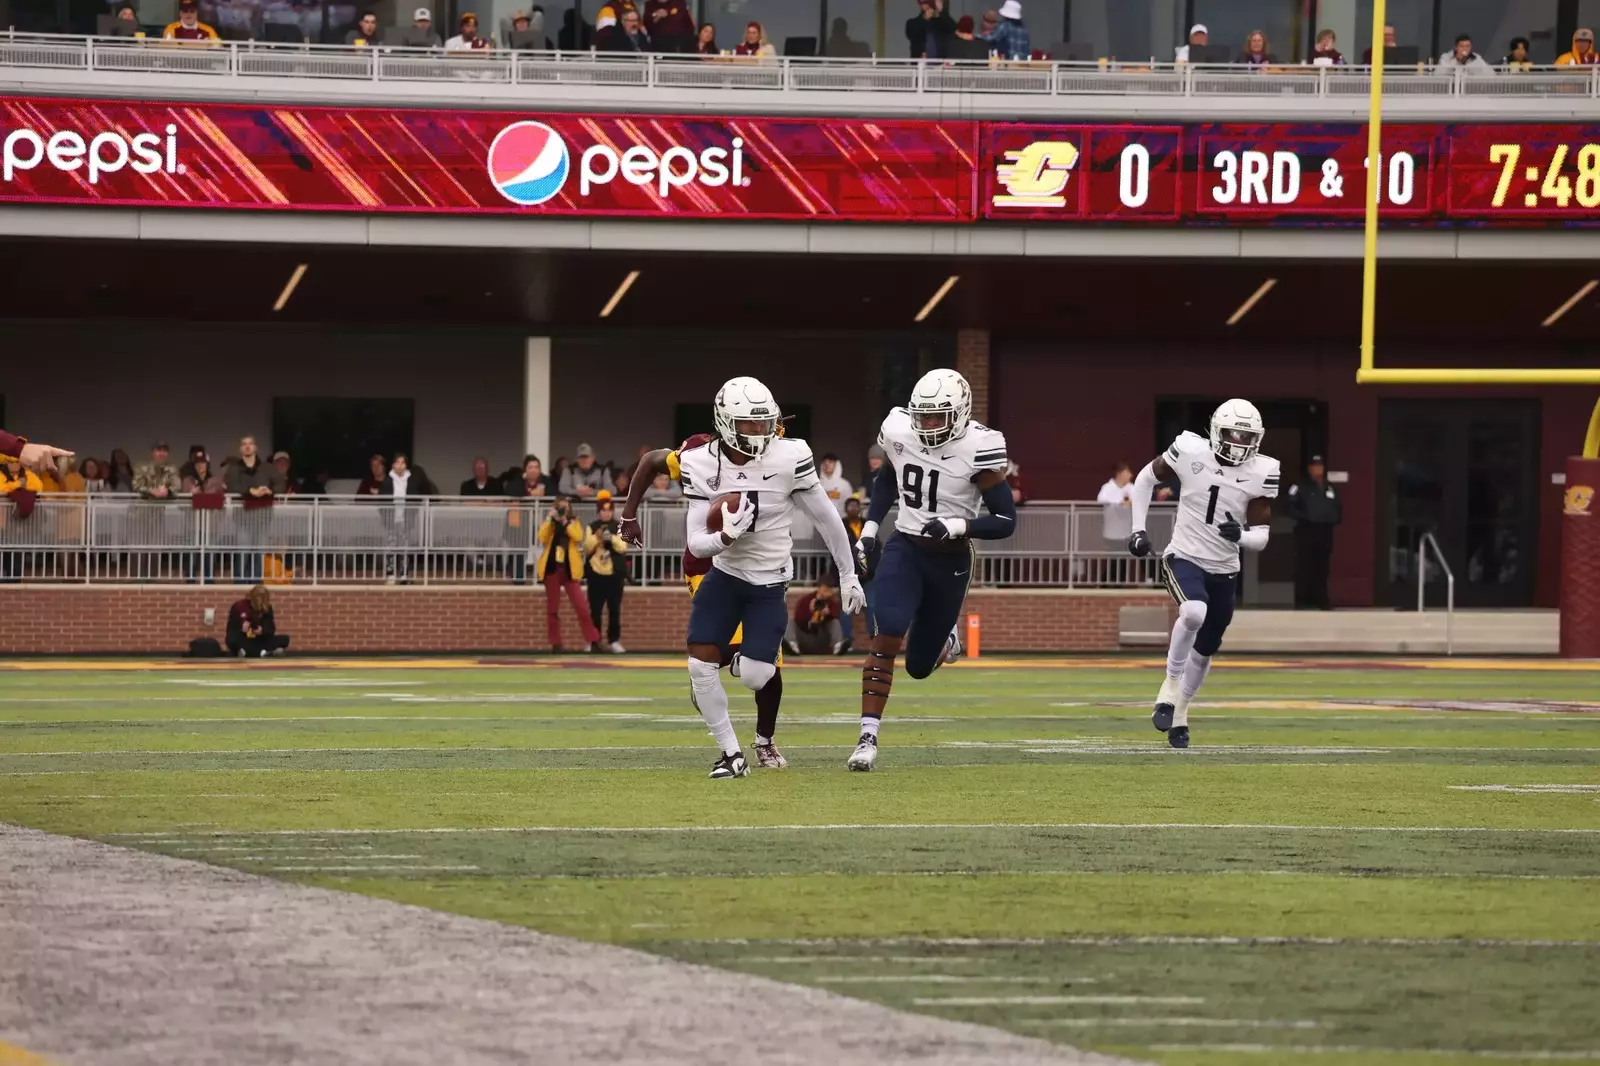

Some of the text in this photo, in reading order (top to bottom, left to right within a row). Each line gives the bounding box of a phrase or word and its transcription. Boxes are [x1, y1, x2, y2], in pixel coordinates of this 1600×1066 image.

[3, 123, 177, 184] pepsi
[579, 136, 743, 198] pepsi
[1119, 143, 1149, 208] 0
[1212, 150, 1300, 204] 3RD
[1319, 158, 1344, 198] &
[1489, 143, 1600, 208] 7:48
[736, 472, 748, 480] A
[903, 463, 940, 513] 91
[1205, 485, 1220, 525] 1
